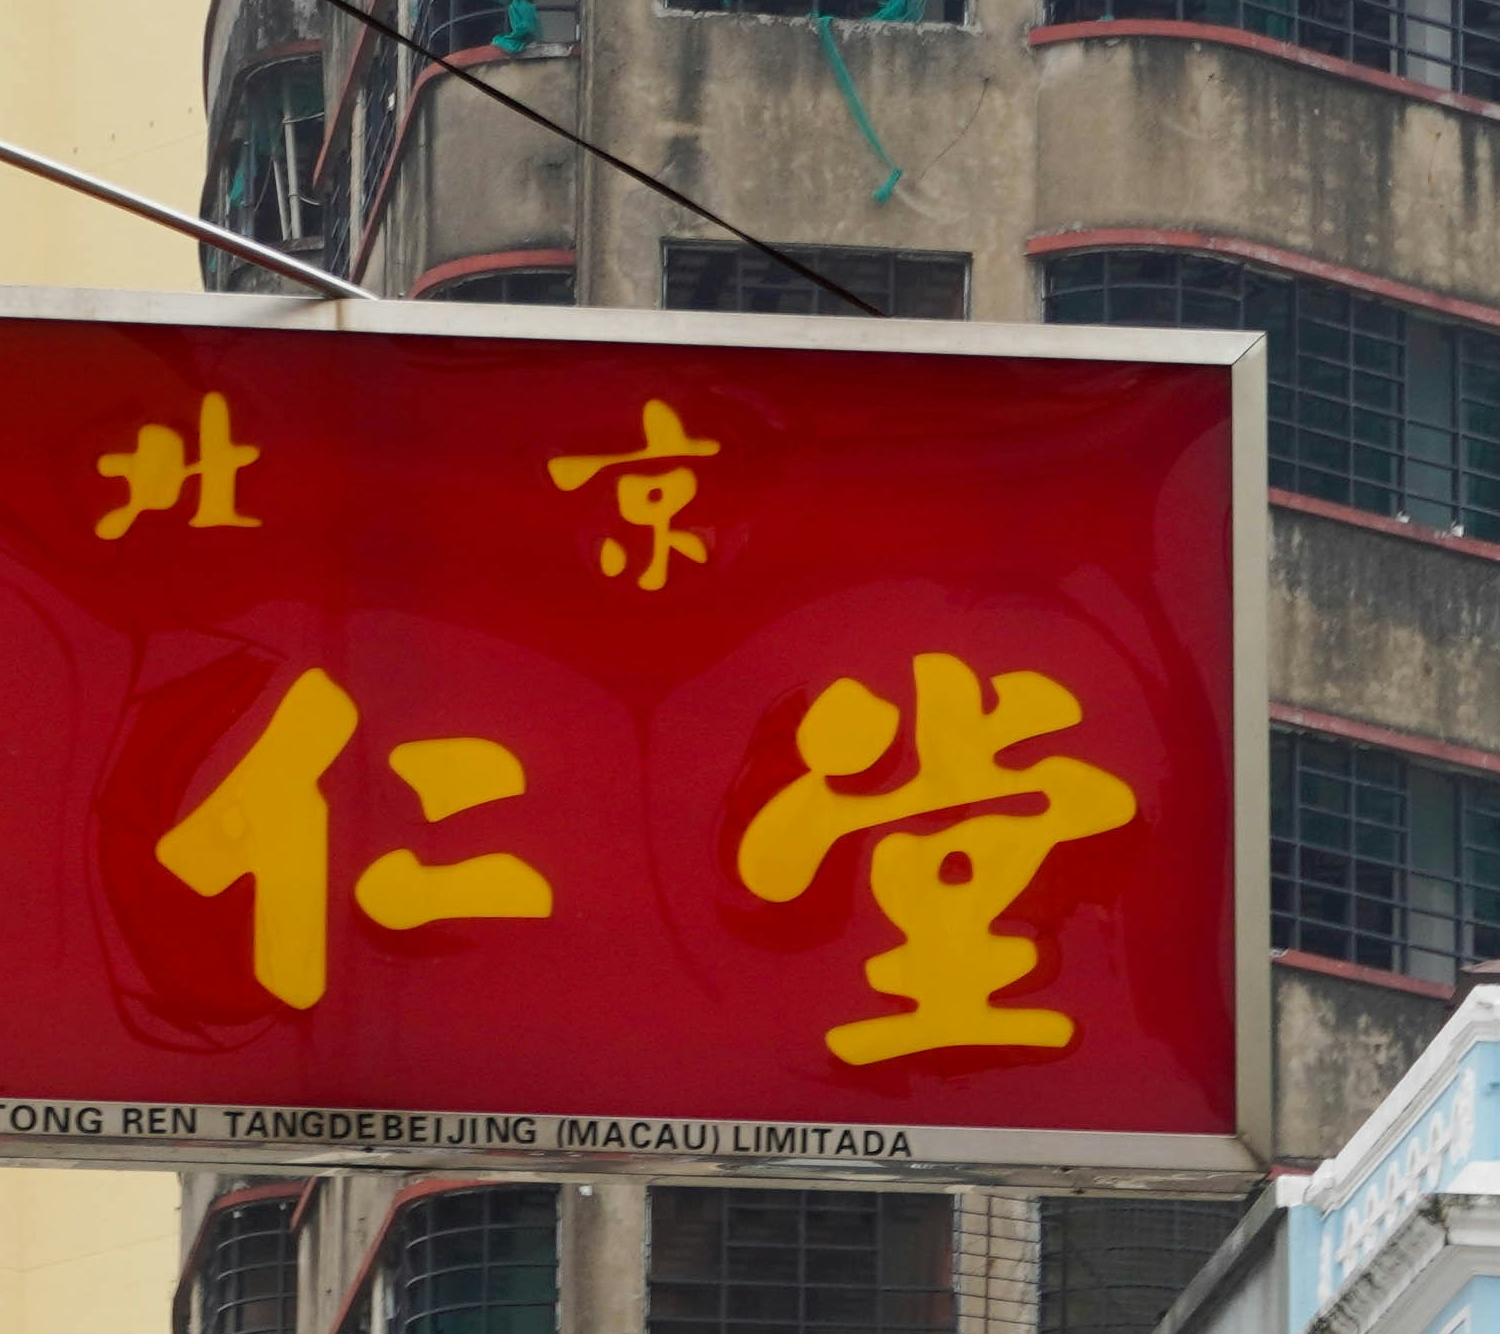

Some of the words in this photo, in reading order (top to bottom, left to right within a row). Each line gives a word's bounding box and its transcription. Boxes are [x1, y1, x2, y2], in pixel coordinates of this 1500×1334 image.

[95, 391, 720, 591] 北京
[122, 1107, 198, 1136] REN
[555, 1118, 720, 1154] (MACAU)
[733, 1125, 913, 1158] LIMITADA
